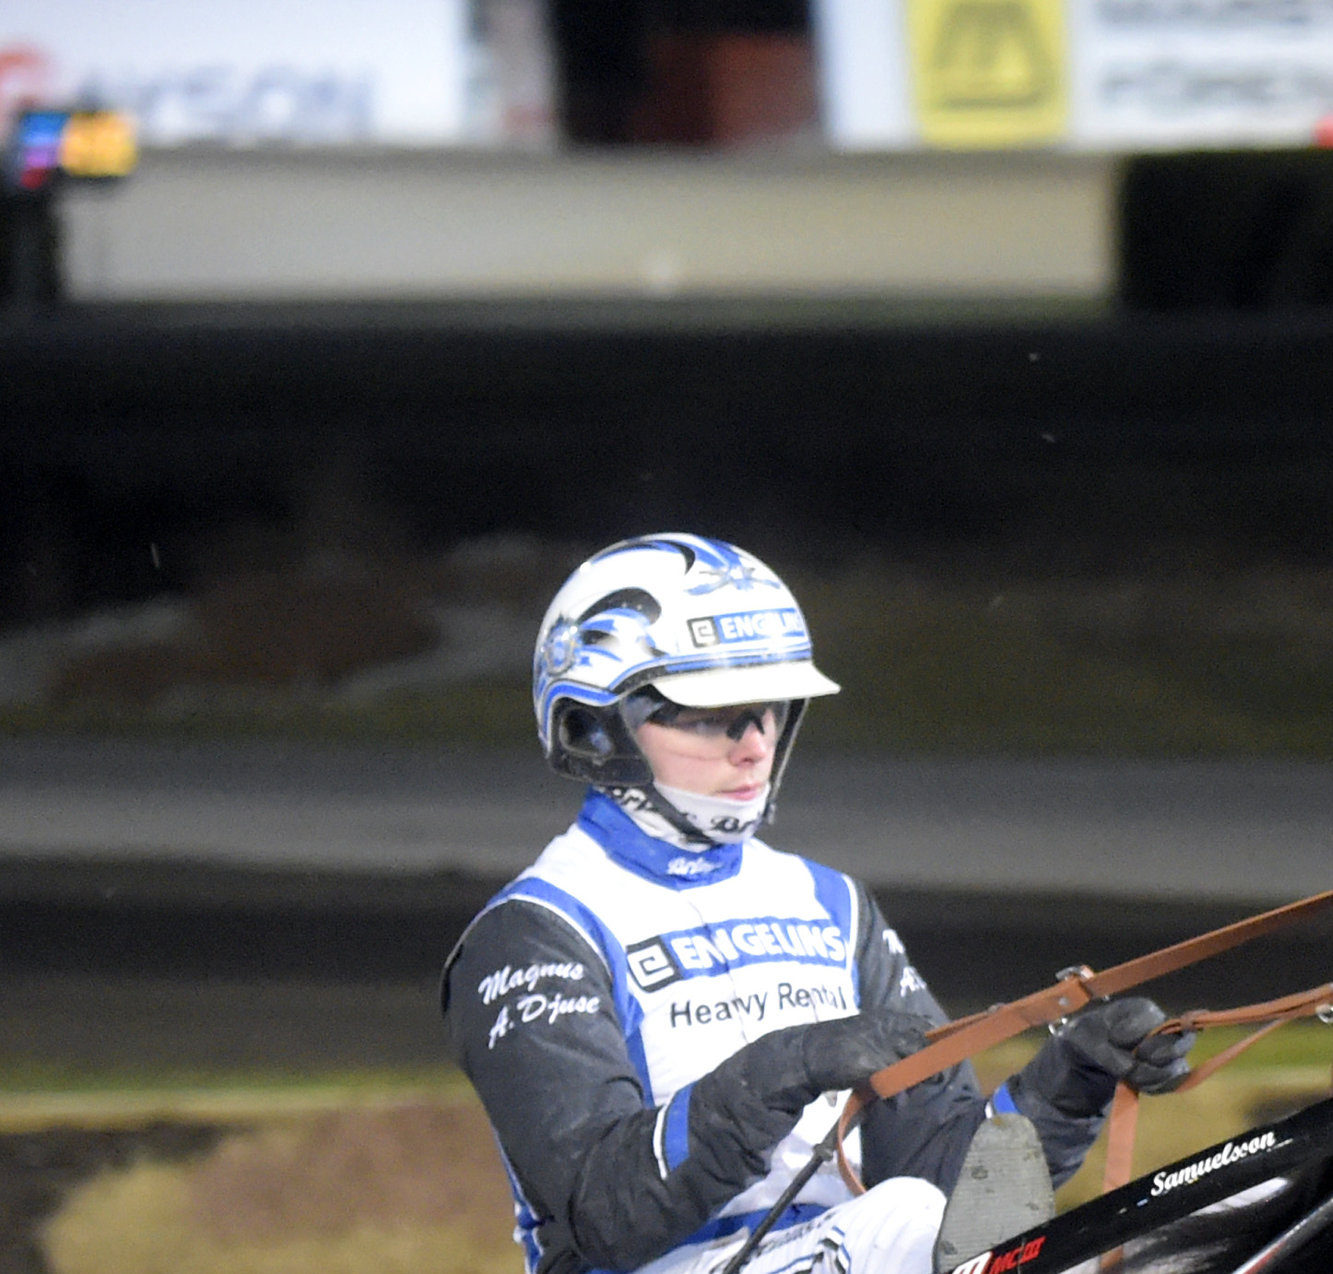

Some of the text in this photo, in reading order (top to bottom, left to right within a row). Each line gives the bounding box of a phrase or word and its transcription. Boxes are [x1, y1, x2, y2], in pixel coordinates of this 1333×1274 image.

[670, 922, 847, 970] ENGELINS
[478, 963, 584, 1005] Magnus
[670, 982, 848, 1028] Heavy Rental
[516, 993, 600, 1024] Djuse
[1151, 1131, 1275, 1197] Samuelsson
